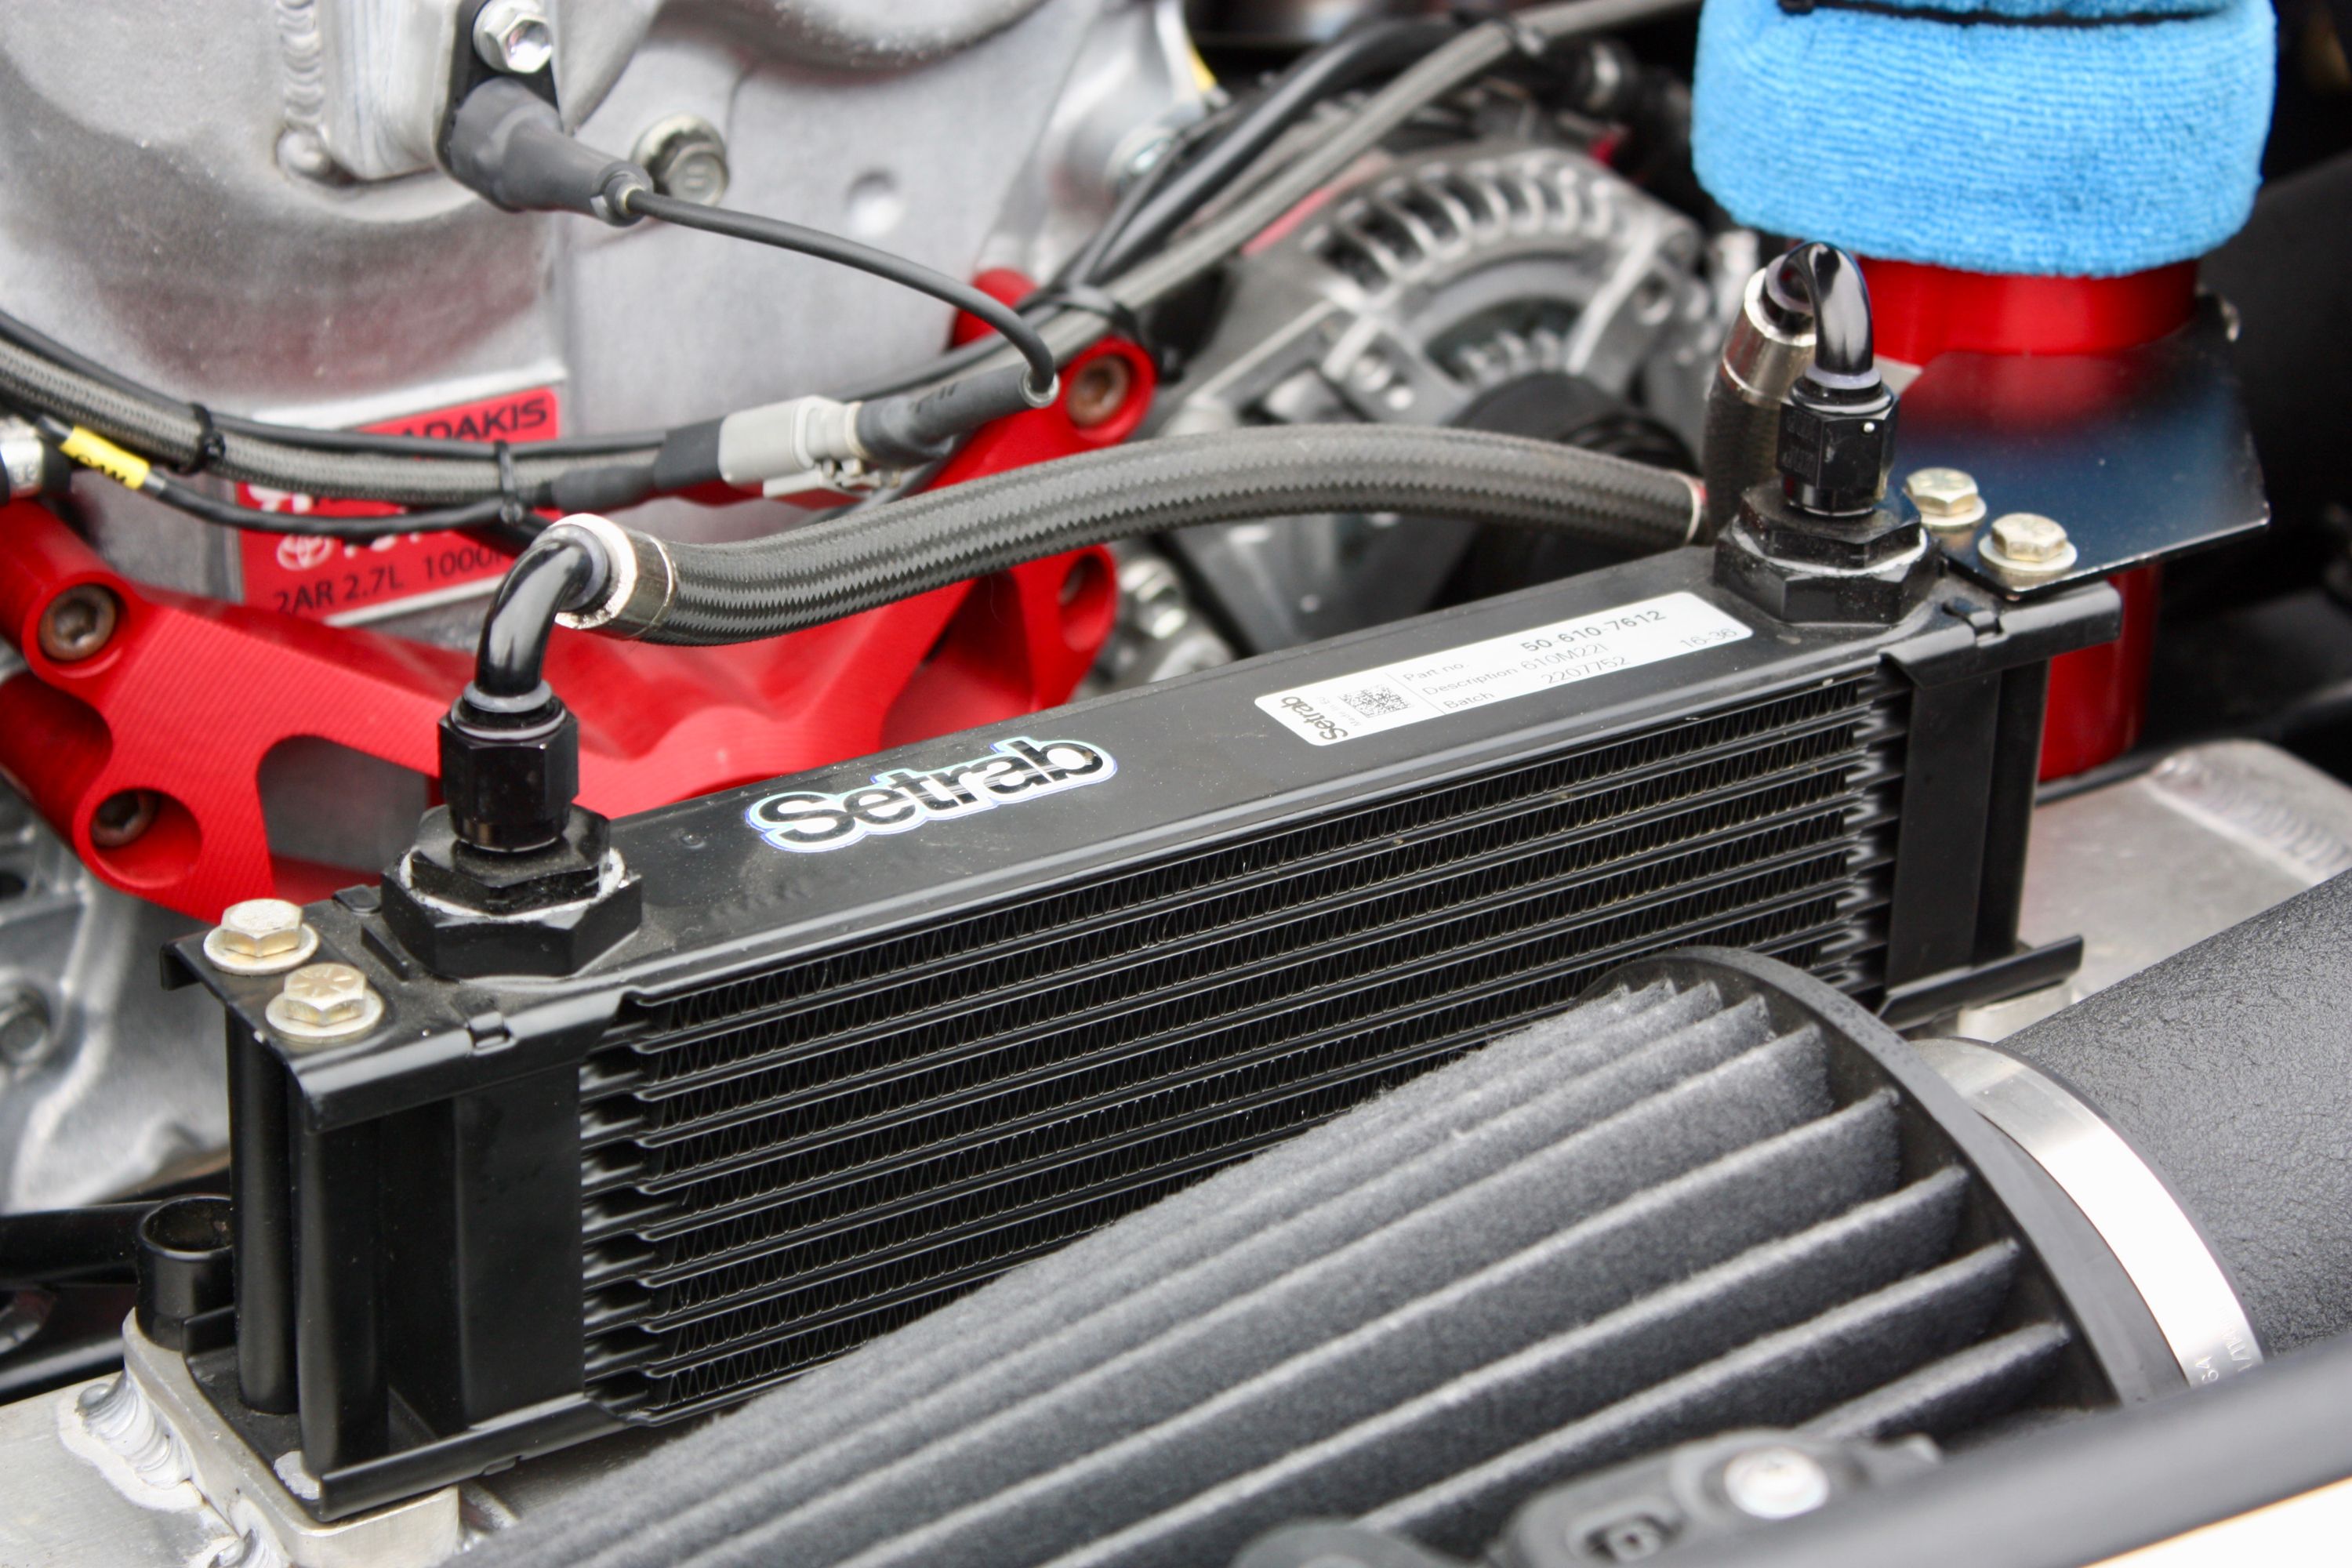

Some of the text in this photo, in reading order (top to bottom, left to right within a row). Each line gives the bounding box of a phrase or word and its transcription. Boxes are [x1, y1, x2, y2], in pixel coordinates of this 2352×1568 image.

[274, 580, 335, 615] 2AR
[343, 565, 405, 601] 2.7L
[1403, 666, 1439, 682] Part
[1521, 610, 1667, 652] 50-610-7612
[1443, 627, 1738, 710] Batch 2207752 16-36
[1421, 666, 1519, 695] Description
[1281, 696, 1348, 740] Setrab
[757, 739, 1104, 844] Setrab
